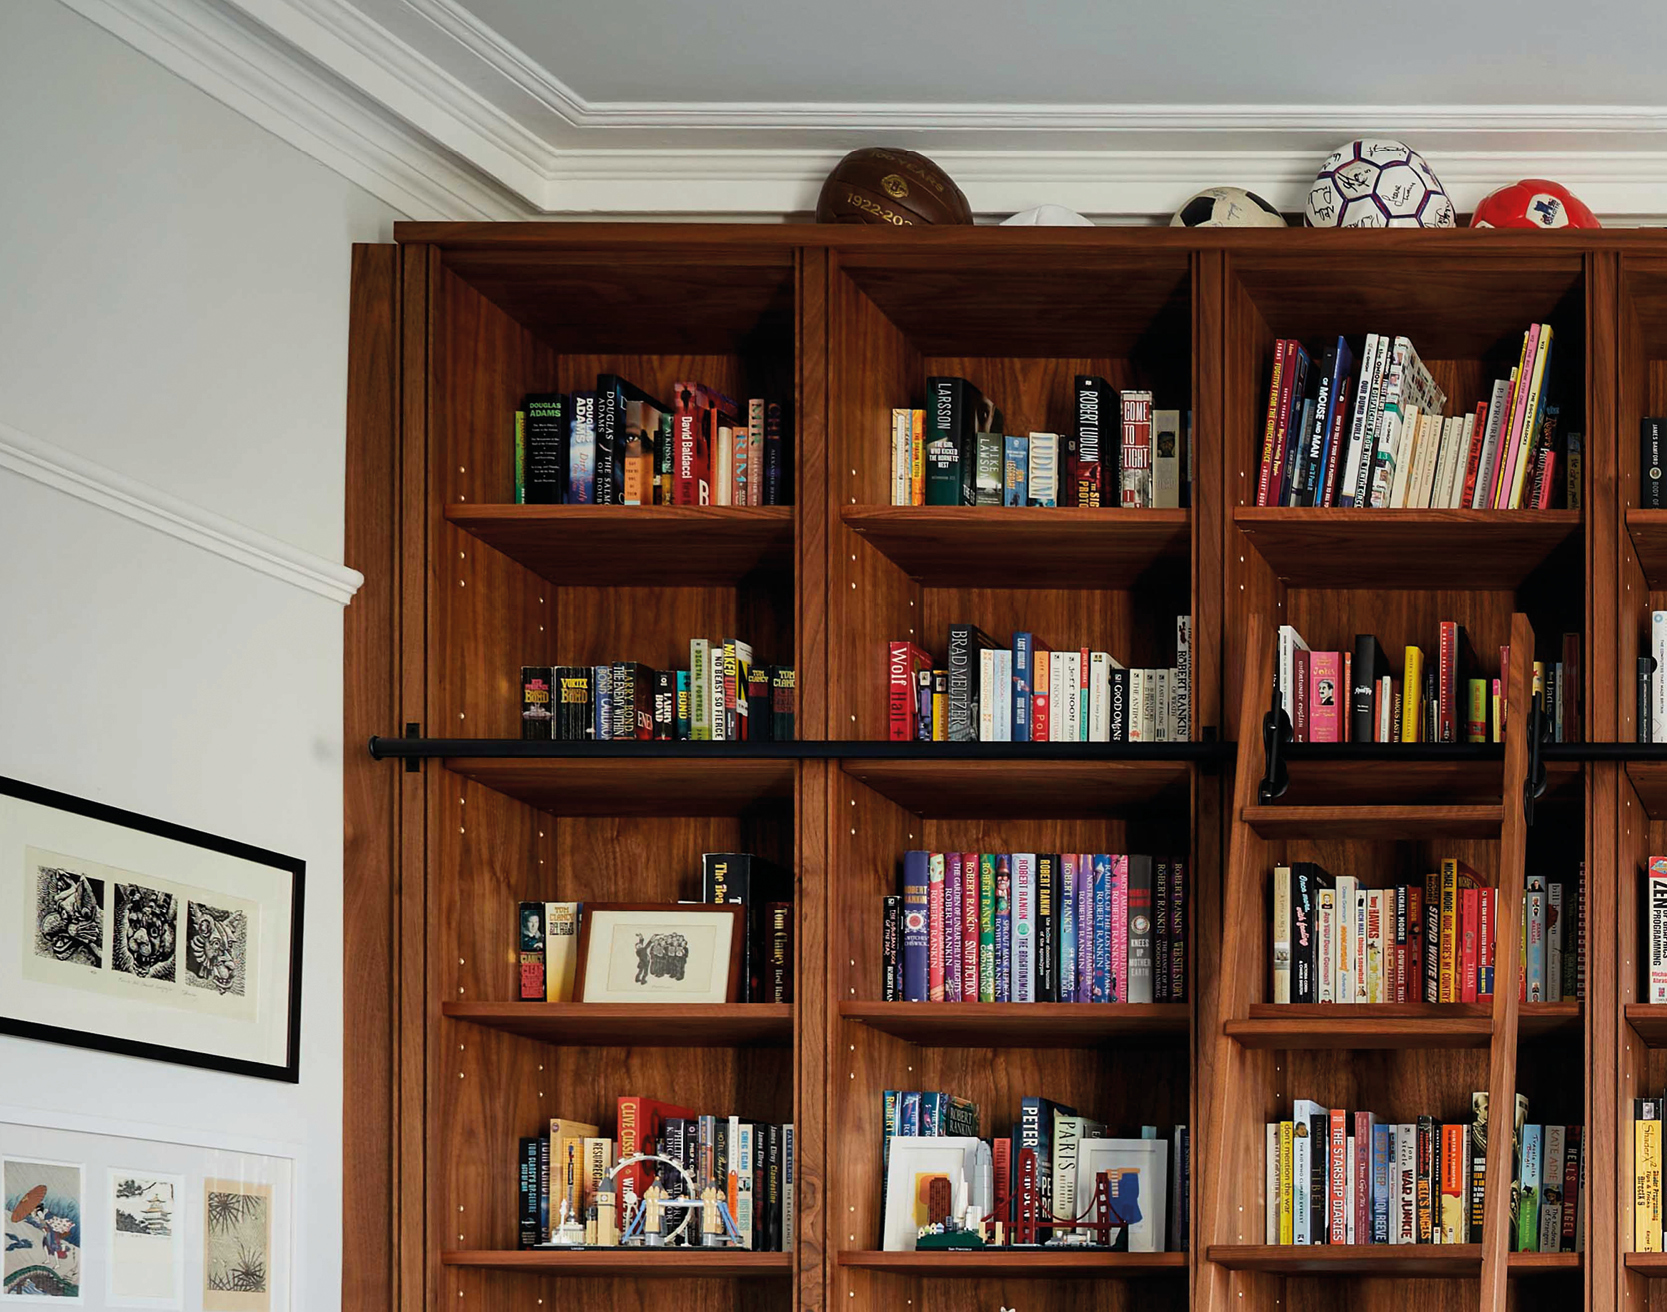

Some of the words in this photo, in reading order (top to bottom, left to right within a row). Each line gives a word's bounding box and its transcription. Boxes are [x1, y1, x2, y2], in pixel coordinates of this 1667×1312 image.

[606, 391, 614, 440] DOUGLAS
[938, 383, 952, 429] LARSSON
[1079, 390, 1098, 425] ROBERT
[1124, 401, 1147, 421] COME
[682, 416, 692, 440] David
[1125, 425, 1134, 444] TO
[1079, 428, 1098, 462] LUDLUM
[1124, 448, 1148, 468] LIGHT
[682, 442, 692, 479] Baldacci
[716, 656, 722, 666] NO
[724, 643, 734, 675] NAKED
[891, 647, 907, 686] Wolf
[561, 679, 588, 688] VORTEX
[561, 689, 588, 703] BOND
[725, 676, 735, 708] LUNCH
[716, 697, 722, 706] SO
[891, 691, 906, 721] Hall
[715, 863, 726, 881] The
[1018, 860, 1028, 888] ROBERT
[774, 909, 787, 929] Tom
[1018, 891, 1028, 920] RANKIN
[1369, 910, 1379, 940] HAWKS
[1429, 906, 1438, 943] STUPID
[774, 932, 787, 966] Clancy
[965, 941, 976, 965] SNUFF
[1427, 946, 1436, 978] WHITE
[965, 966, 976, 995] FICTION
[1426, 979, 1436, 1003] MEN
[622, 1103, 635, 1128] CLIVE
[1023, 1105, 1038, 1146] PETER
[1333, 1128, 1342, 1144] THE
[1333, 1148, 1342, 1197] STARSHIP
[1402, 1169, 1413, 1194] WAR
[1333, 1200, 1342, 1240] DIARIES
[1401, 1197, 1412, 1238] JUNKIE
